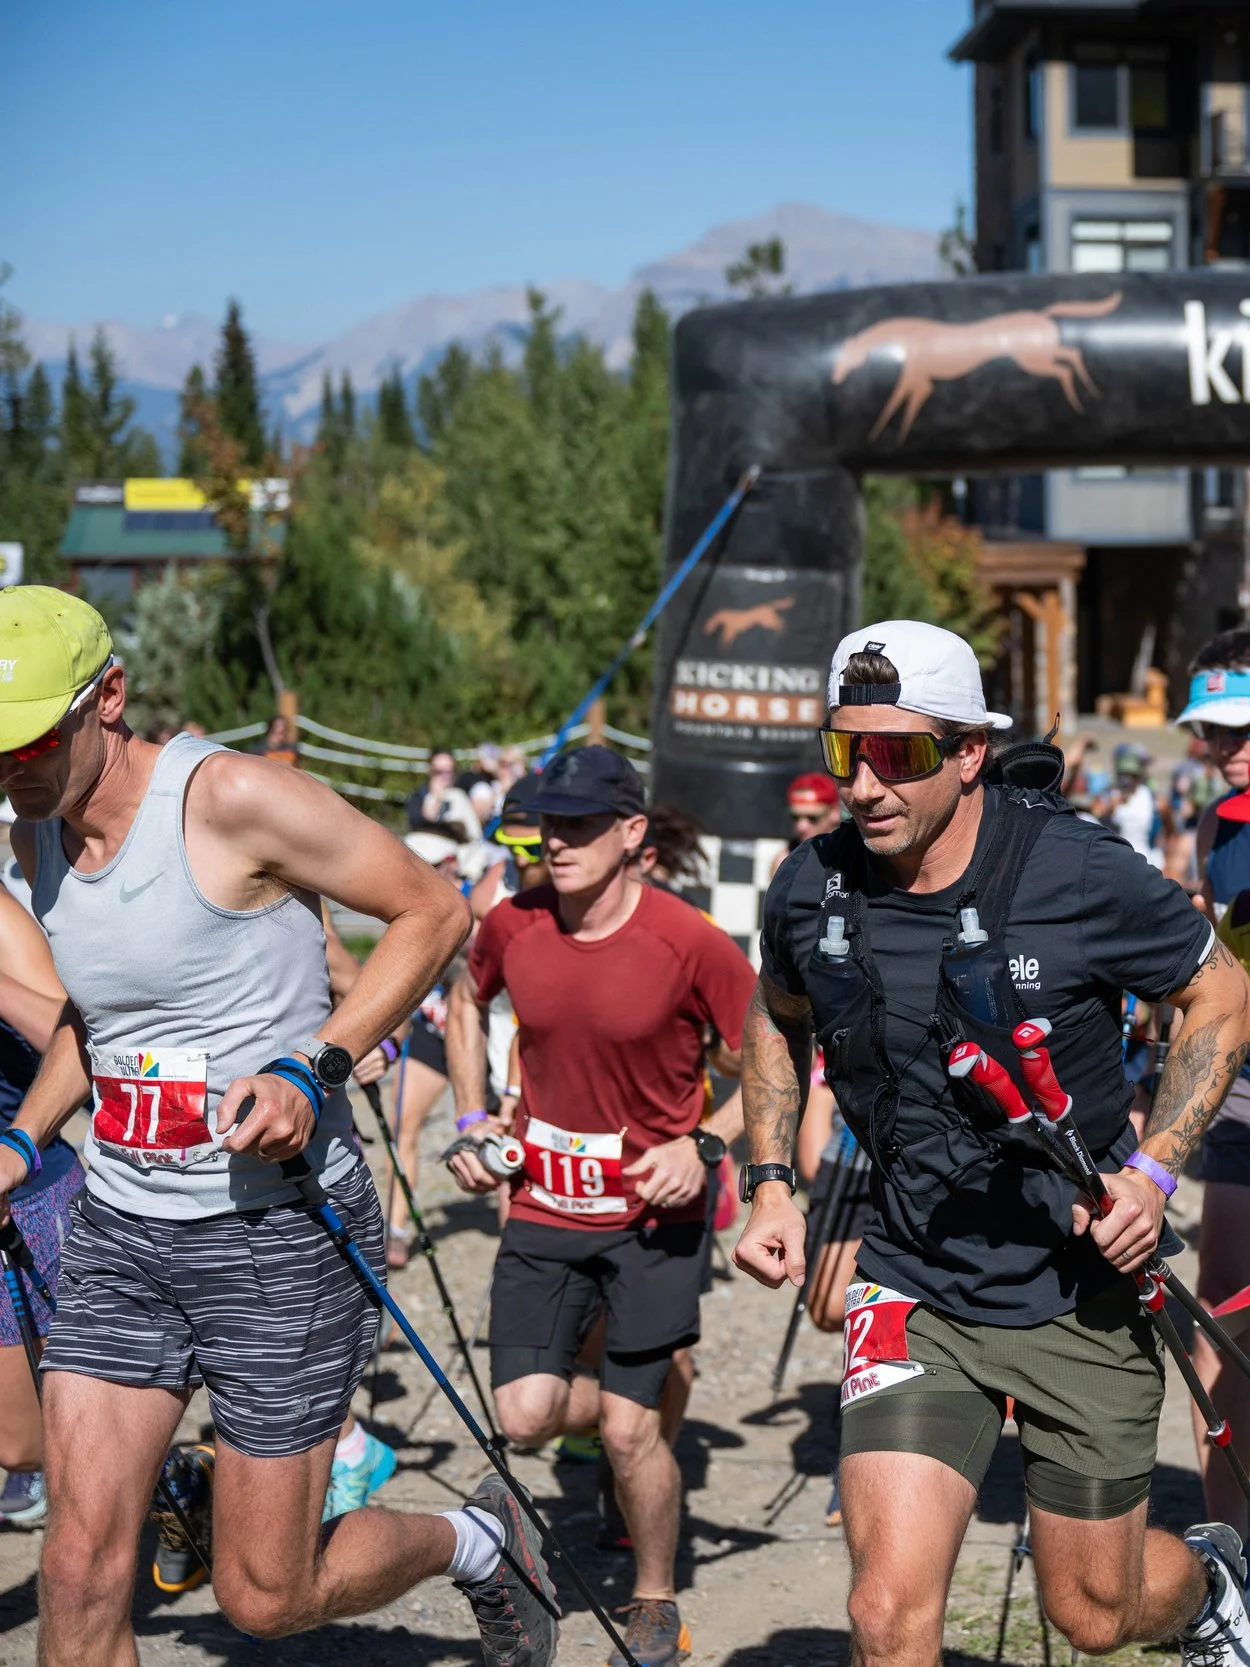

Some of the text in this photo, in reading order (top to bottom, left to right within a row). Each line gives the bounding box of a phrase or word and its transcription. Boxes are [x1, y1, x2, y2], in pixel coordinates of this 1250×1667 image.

[675, 659, 821, 693] KICKING
[673, 690, 819, 723] HORSE
[1014, 981, 1041, 990] nning
[113, 1055, 139, 1067] GOLDEN
[120, 1083, 162, 1144] 77
[538, 1150, 606, 1197] 119
[850, 1372, 880, 1396] Pint
